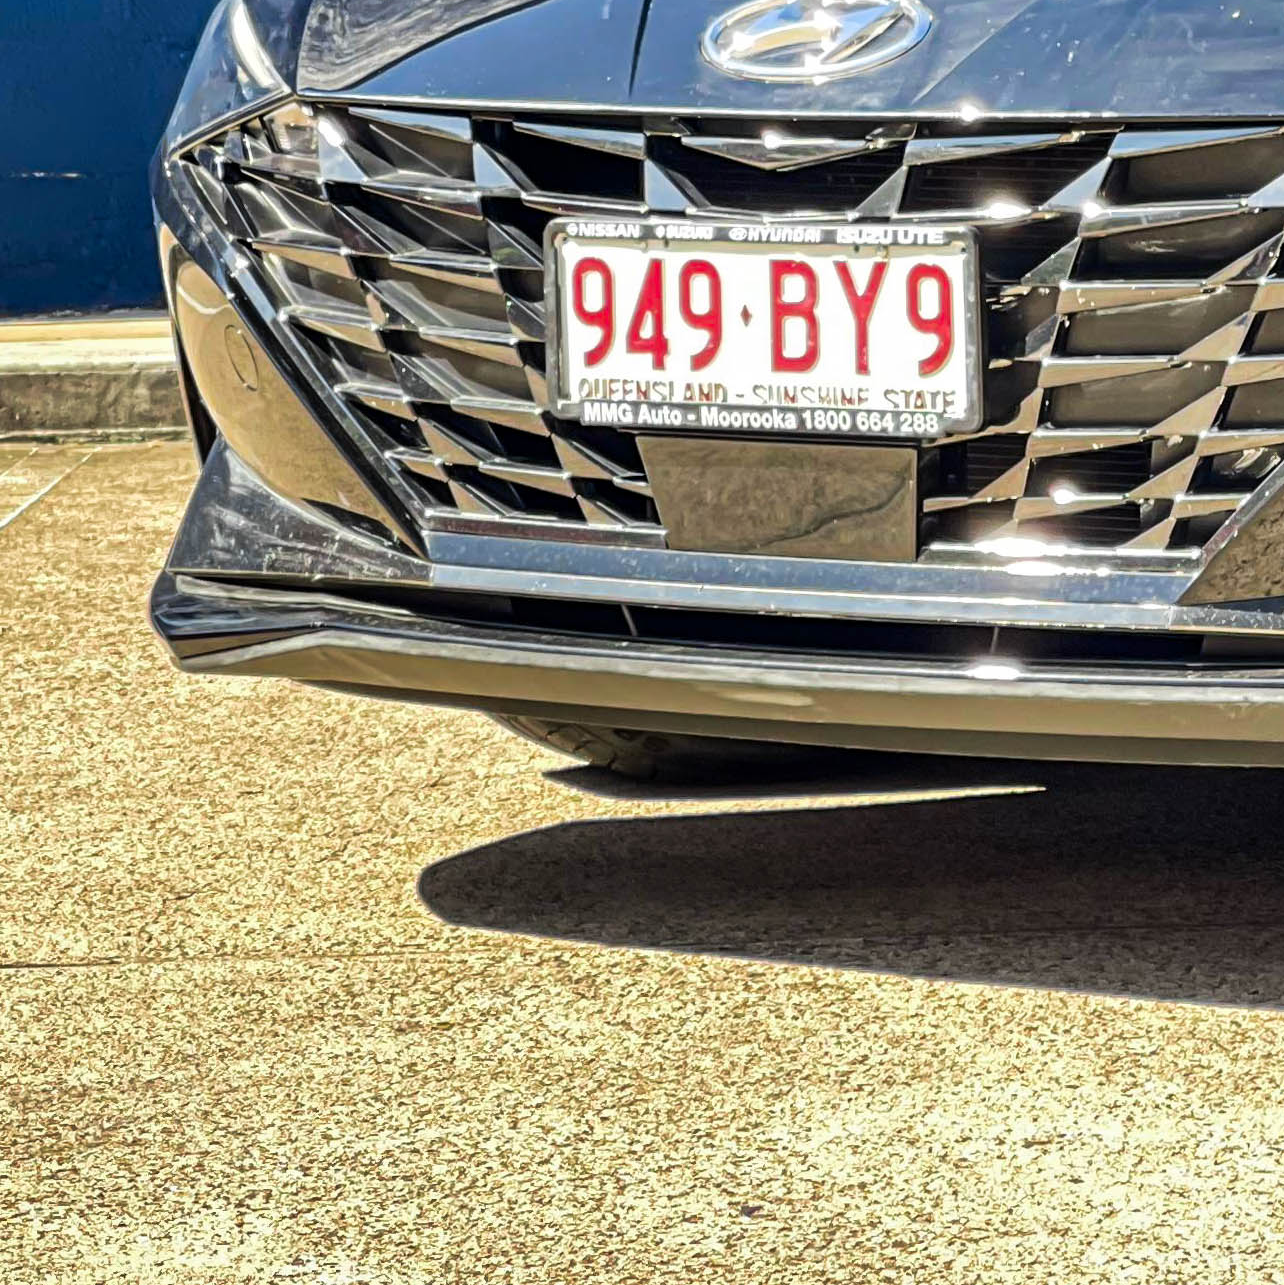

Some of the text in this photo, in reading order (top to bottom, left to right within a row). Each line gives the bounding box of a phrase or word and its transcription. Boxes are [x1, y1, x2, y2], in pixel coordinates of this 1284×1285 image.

[578, 222, 641, 238] NISSAN
[748, 226, 821, 242] HYUNDAI
[898, 226, 945, 245] UTE
[578, 377, 728, 403] QUEENSLAND
[752, 383, 870, 406] SUNSHINE
[883, 387, 956, 414] STATE
[583, 401, 633, 423] MMG
[637, 403, 682, 426] Auto
[700, 405, 798, 430] Moorooka
[802, 410, 850, 431] 1800
[856, 411, 895, 433] 664
[900, 412, 940, 434] 288
